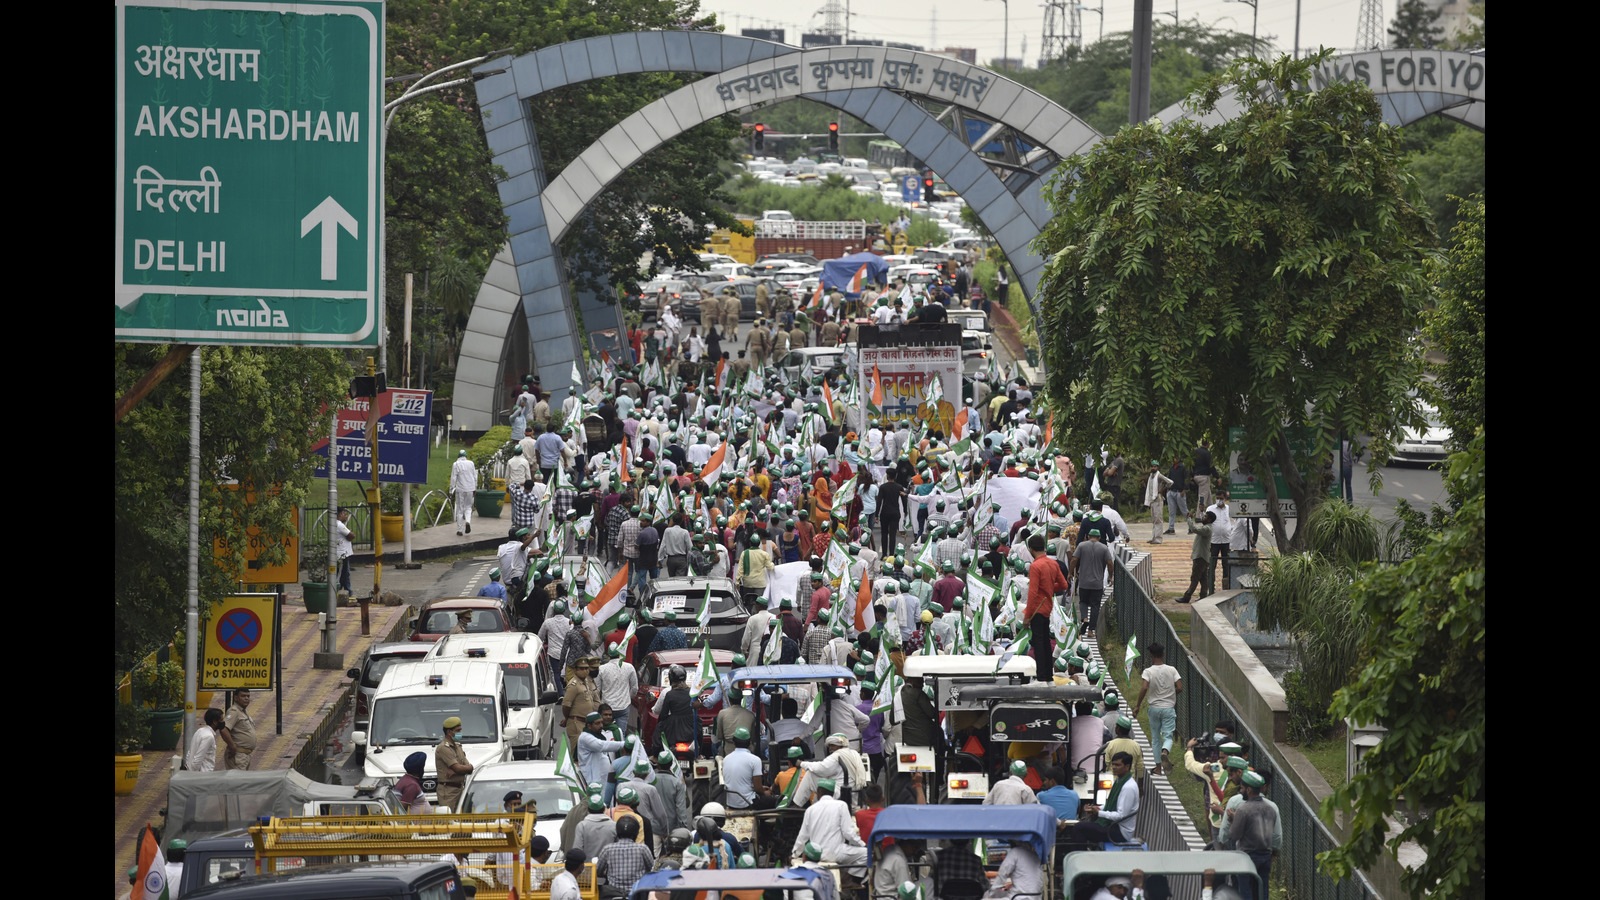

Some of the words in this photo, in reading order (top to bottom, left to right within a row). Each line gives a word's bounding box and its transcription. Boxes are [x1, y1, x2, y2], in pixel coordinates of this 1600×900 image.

[134, 45, 260, 81] अक्षरधाम
[1381, 57, 1437, 87] FOR
[716, 65, 799, 101] धन्यवाद
[809, 58, 874, 90] कृपया
[933, 67, 990, 101] पधारें
[134, 105, 359, 143] AKSHARDHAM
[133, 165, 222, 213] दिल्ली
[134, 239, 225, 272] DELHI
[405, 399, 423, 410] 112
[393, 421, 425, 435] नोएडा
[329, 445, 371, 458] FFICE
[221, 669, 267, 678] STANDING
[222, 657, 268, 667] STOPPING
